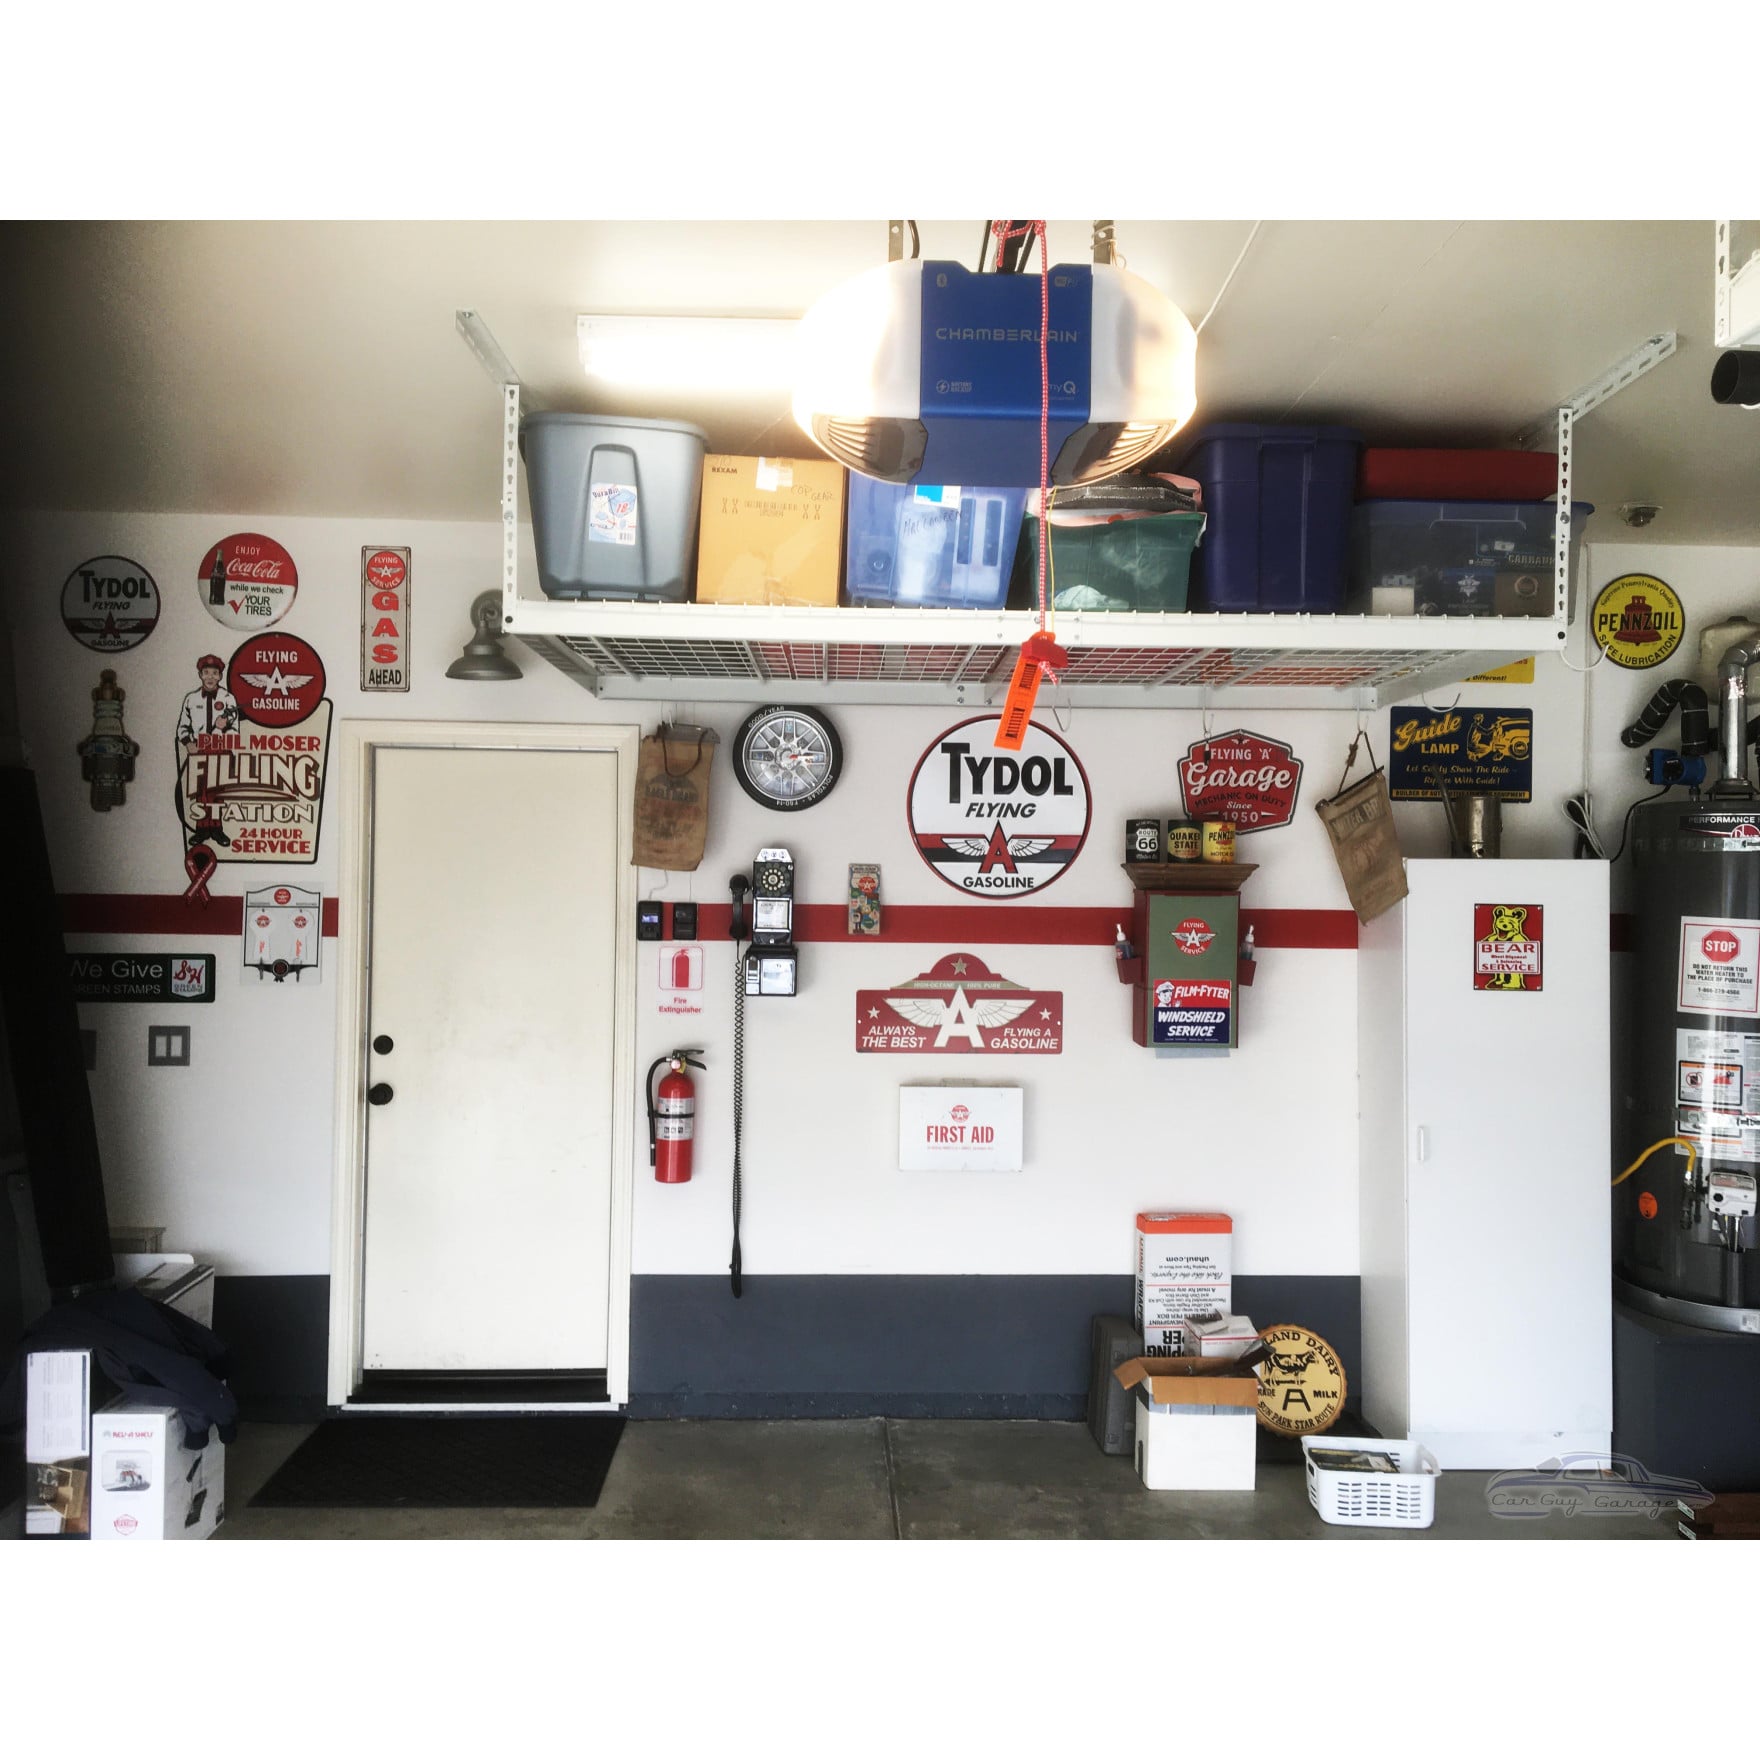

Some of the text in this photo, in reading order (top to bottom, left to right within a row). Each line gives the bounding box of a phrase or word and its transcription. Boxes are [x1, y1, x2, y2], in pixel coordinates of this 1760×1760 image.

[936, 327, 1078, 343] CHAMBERLAIN
[235, 545, 261, 556] ENJOY
[374, 556, 398, 564] FLYING
[78, 570, 150, 602] TYDOL
[230, 583, 249, 592] while
[262, 585, 284, 594] check
[370, 576, 401, 589] SERVICE
[245, 595, 270, 605] YOUR
[92, 602, 130, 611] FLYING
[245, 604, 272, 616] TIRES
[1598, 611, 1678, 632] PENNZOIL
[90, 638, 130, 647] GASOLINE
[1599, 634, 1677, 665] SAFE LUBRICATION
[256, 650, 298, 663] FLYING
[368, 669, 402, 685] AHEAD
[252, 698, 300, 711] GASOLINE
[1393, 712, 1463, 752] Guide
[197, 734, 321, 751] PHIL MOSER
[1421, 743, 1460, 754] LAMP
[1210, 748, 1252, 760] FLYING
[941, 742, 1074, 804] TYDOL
[1422, 765, 1448, 774] Saty
[186, 753, 320, 801] FILLING
[1186, 762, 1292, 796] Garage
[1454, 776, 1474, 784] With
[1194, 792, 1287, 808] MECHANIC ON DUTY
[1226, 800, 1253, 809] Since
[189, 802, 314, 824] STATION
[965, 802, 1037, 818] FLYING
[1222, 811, 1259, 823] 1950
[1688, 816, 1756, 824] PERFORMANCE
[239, 828, 303, 840] 24 HOUR
[231, 840, 311, 854] SERVICE
[978, 820, 1018, 874] A
[1138, 838, 1157, 850] 66
[1174, 841, 1199, 849] STATE
[963, 876, 1035, 889] GASOLINE
[1180, 946, 1206, 954] SERVICE
[1481, 944, 1536, 953] BEAR
[1705, 940, 1736, 952] STOP
[112, 959, 163, 978] Give
[113, 984, 161, 994] STAMPS
[1174, 984, 1230, 1000] FILM-FYTER
[658, 1006, 702, 1014] Extinguisher
[1158, 1010, 1226, 1024] WINDSHIELD
[868, 1026, 916, 1036] ALWAYS
[1004, 1028, 1052, 1037] FLYING A
[1167, 1025, 1216, 1037] SERVICE
[862, 1036, 927, 1048] THE BEST
[990, 1038, 1059, 1049] GASOLINE
[926, 1126, 994, 1143] FIRST AID
[1162, 1330, 1184, 1344] ER
[1147, 1345, 1184, 1357] PING
[1262, 1331, 1340, 1376] LAND DAIRY
[1258, 1388, 1276, 1398] RADE
[1313, 1390, 1338, 1399] MILK
[1258, 1401, 1335, 1430] SUN PARK STAR ROUTE
